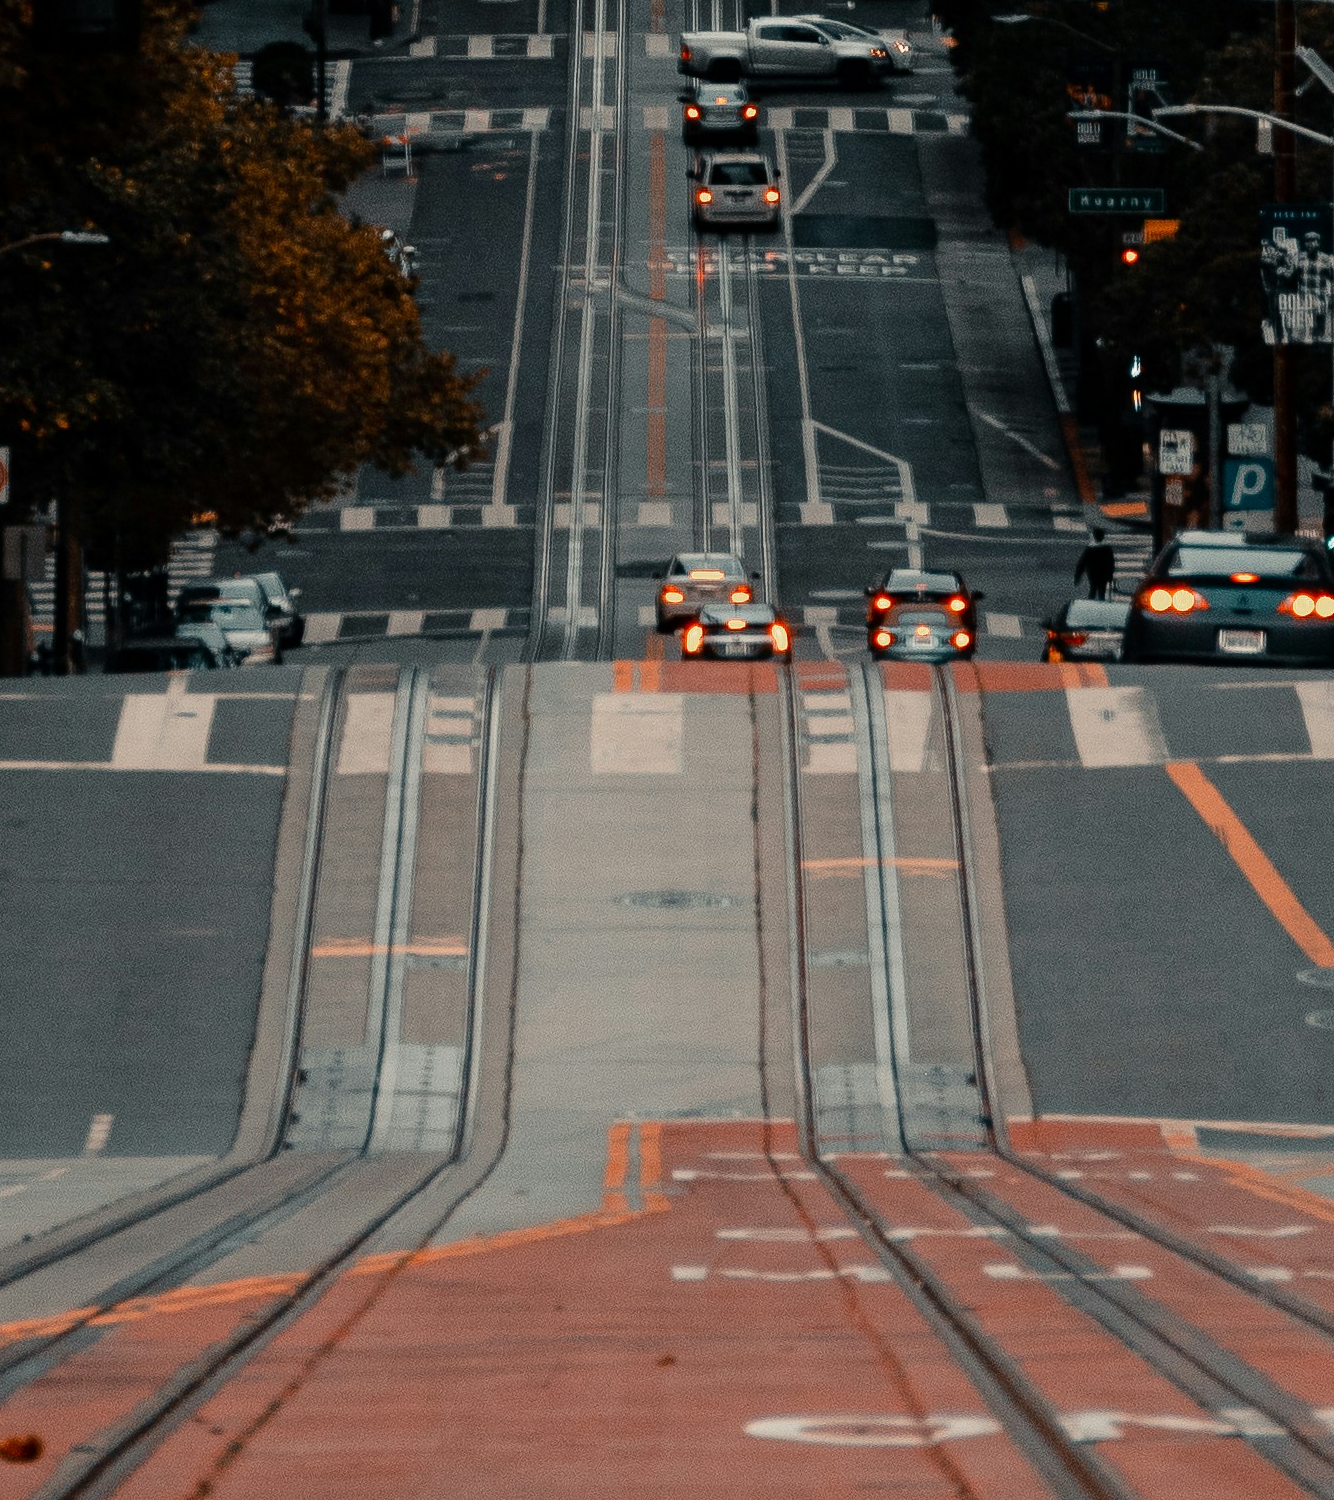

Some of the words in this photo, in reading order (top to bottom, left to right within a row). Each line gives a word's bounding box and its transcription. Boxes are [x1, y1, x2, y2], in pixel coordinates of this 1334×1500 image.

[1080, 194, 1154, 211] Kearny
[809, 264, 908, 276] KEEP
[1278, 293, 1314, 311] BOLD
